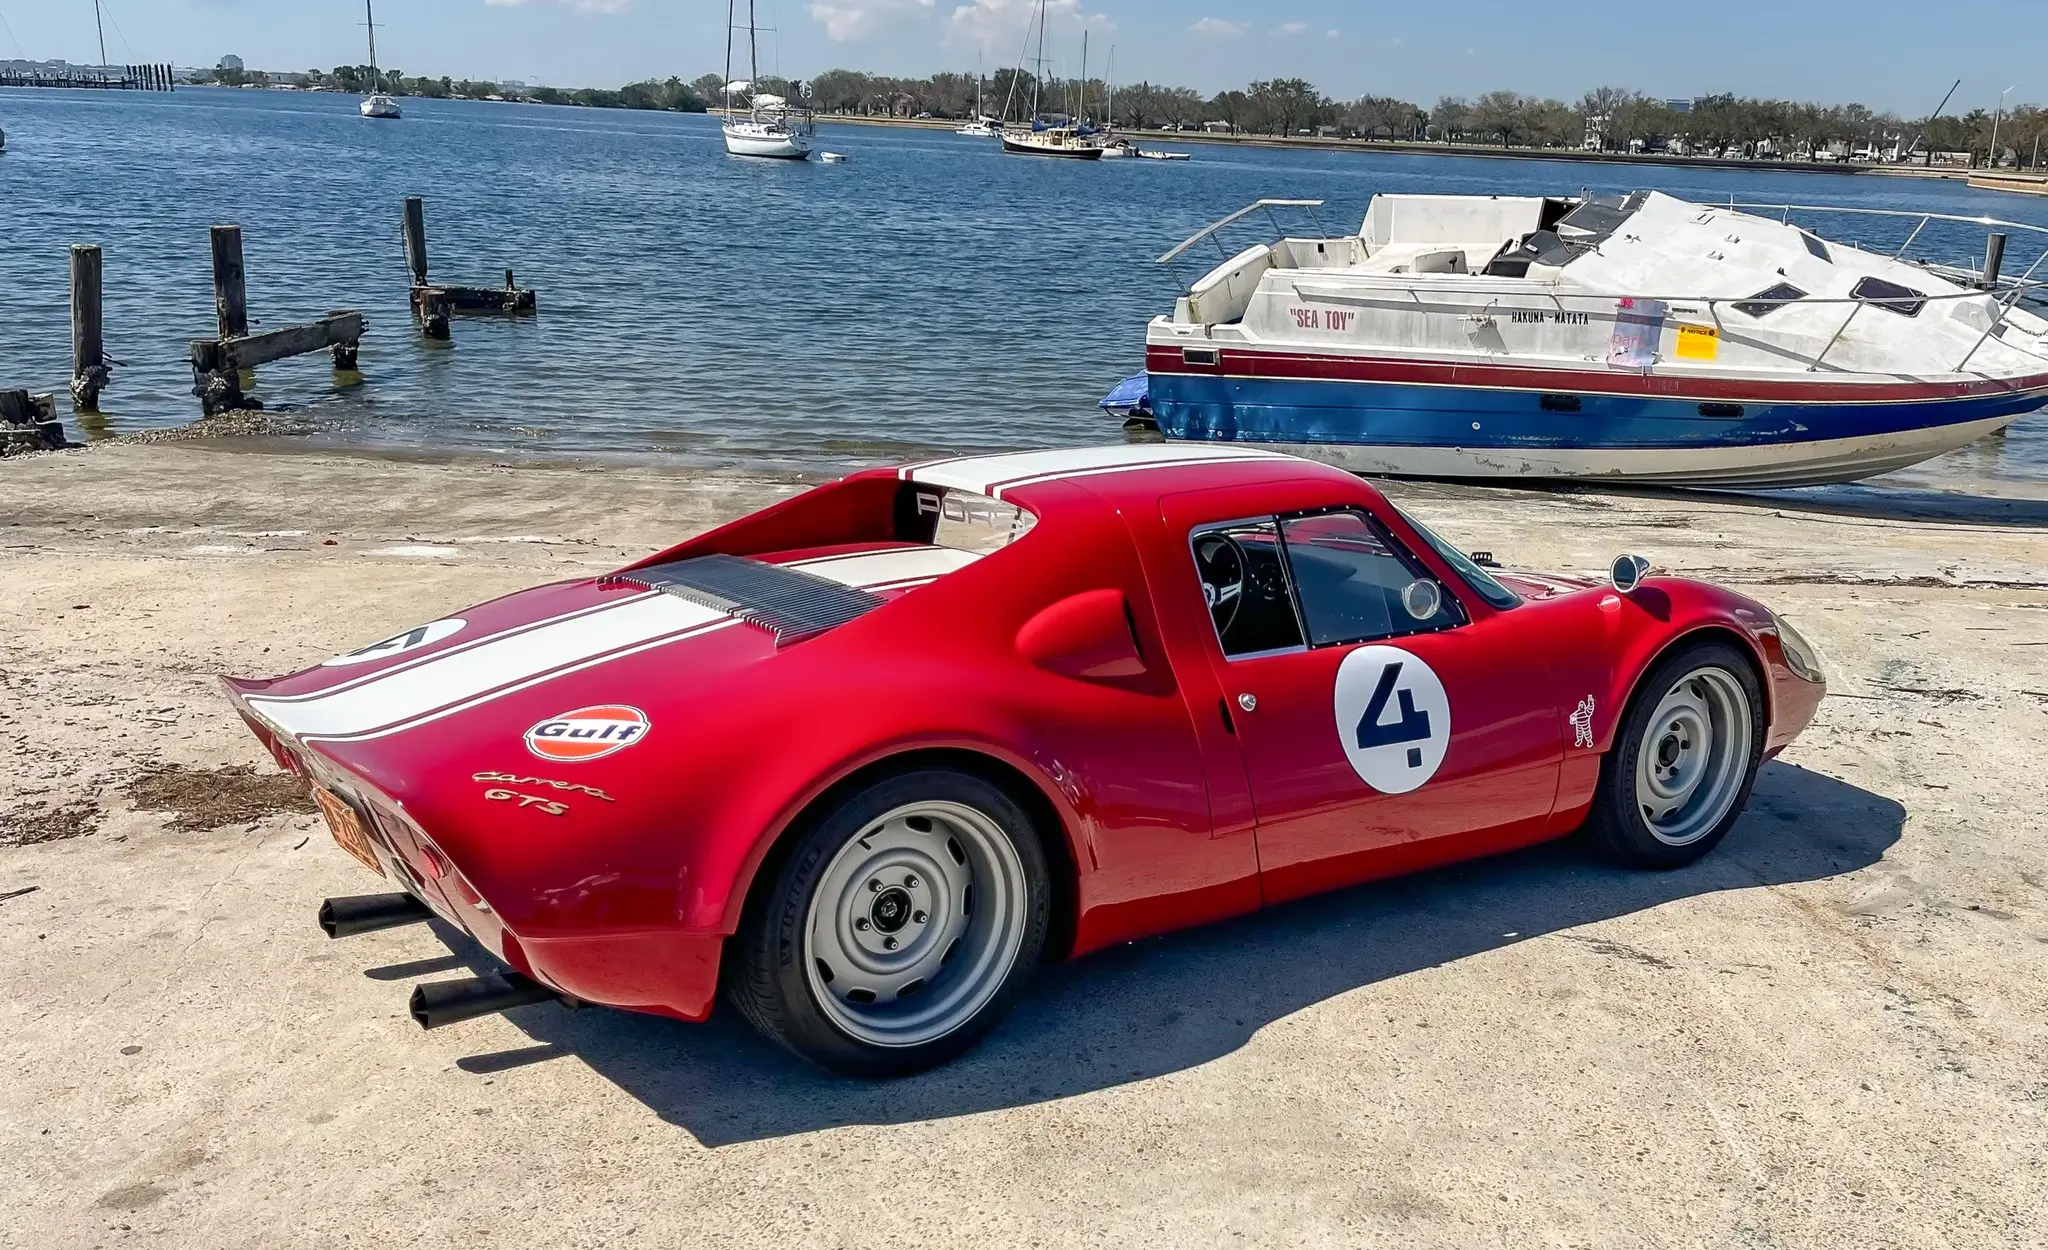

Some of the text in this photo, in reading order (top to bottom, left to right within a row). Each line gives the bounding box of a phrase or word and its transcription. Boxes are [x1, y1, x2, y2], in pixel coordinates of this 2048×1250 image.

[1289, 308, 1355, 331] "SEA TOY"
[1511, 311, 1545, 324] HAKUNA
[916, 491, 998, 529] POR
[1356, 661, 1432, 769] 4
[534, 721, 642, 741] Gulf
[471, 770, 616, 803] Carrera
[484, 788, 571, 817] GTS
